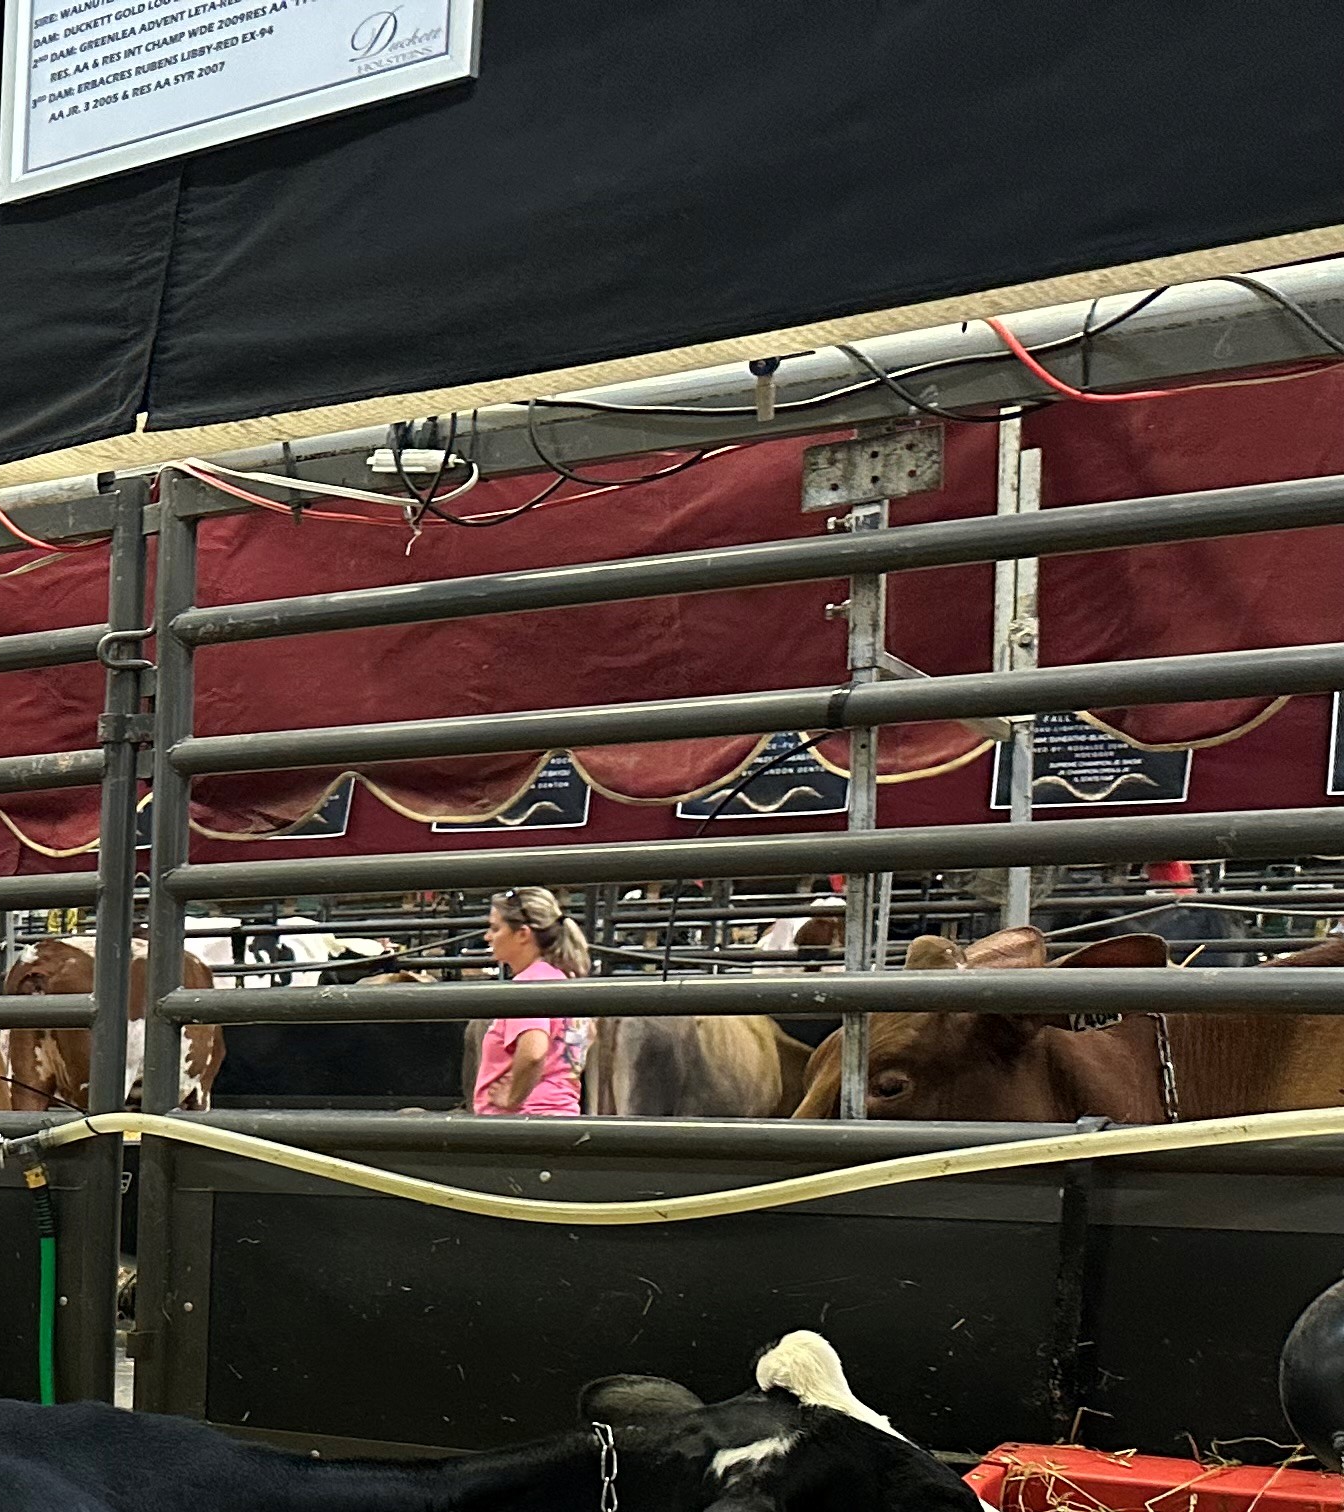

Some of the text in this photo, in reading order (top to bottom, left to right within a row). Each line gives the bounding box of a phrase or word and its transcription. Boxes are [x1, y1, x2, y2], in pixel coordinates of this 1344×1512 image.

[33, 32, 60, 49] DAM:
[64, 13, 113, 38] DUCKETT
[114, 3, 146, 21] GOLD
[73, 62, 90, 75] AA
[92, 58, 100, 69] &
[102, 52, 122, 66] RES
[123, 45, 144, 59] INT
[145, 32, 186, 52] CHAMP
[188, 22, 215, 39] WDE
[269, 0, 288, 14] AA
[79, 27, 137, 52] GREENLEA
[138, 11, 187, 34] ADVENT
[134, 54, 178, 76] RUBENS
[48, 110, 65, 123] AA
[83, 101, 91, 112] 3
[92, 93, 119, 109] 2005
[121, 90, 130, 101] &
[132, 83, 152, 98] RES
[153, 78, 171, 91] AA
[173, 71, 195, 85] 5YR
[197, 61, 225, 78] 2007
